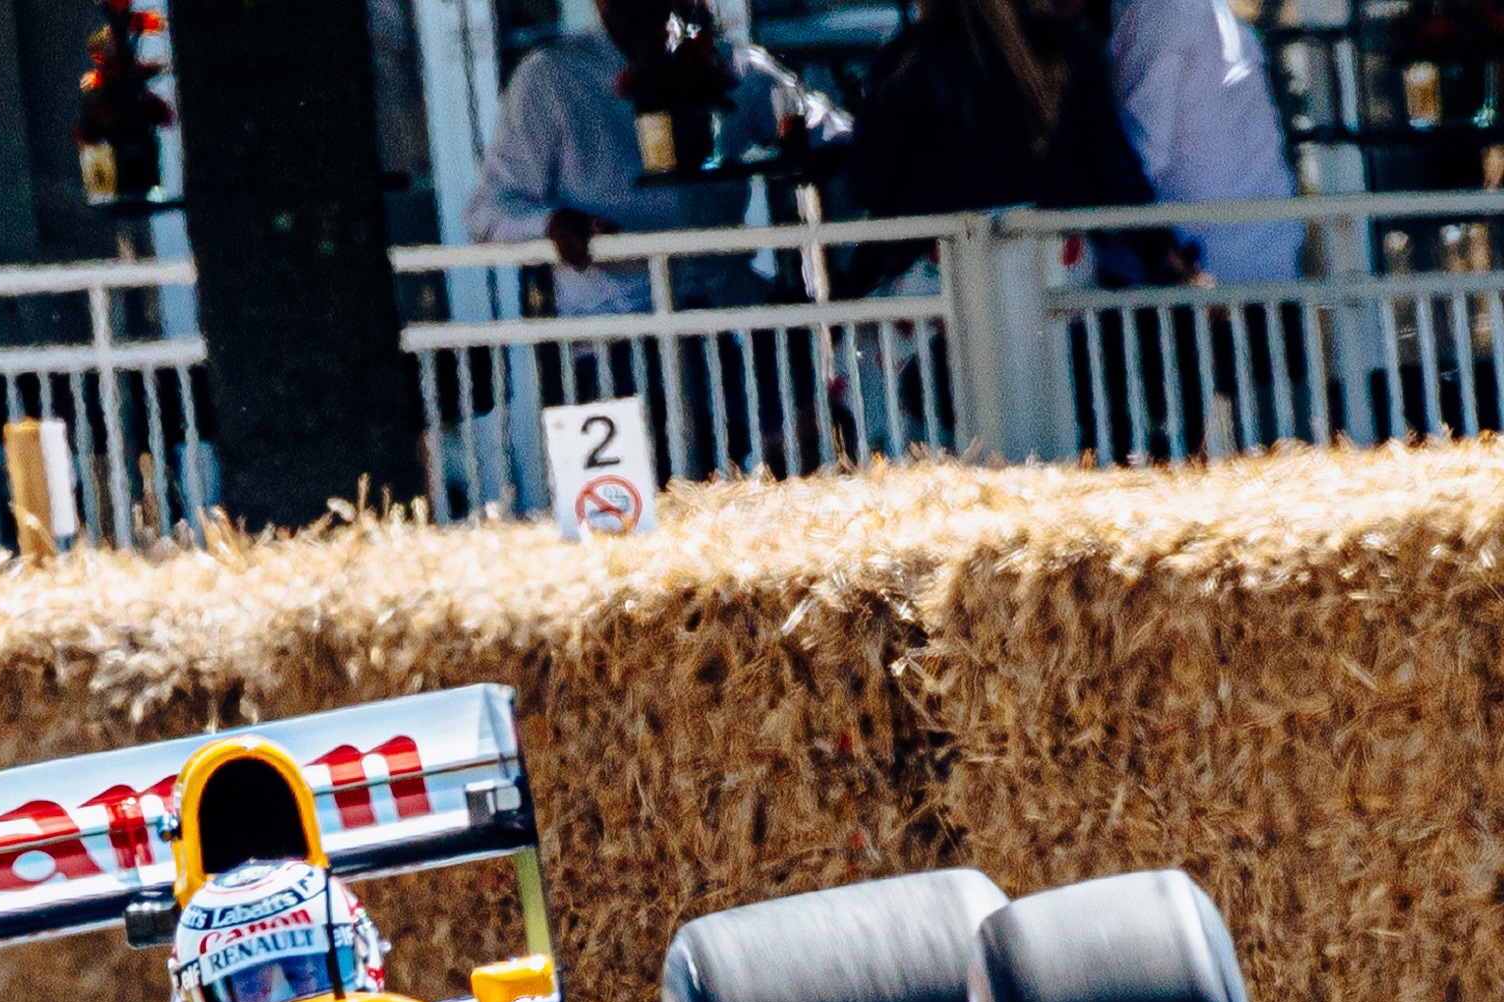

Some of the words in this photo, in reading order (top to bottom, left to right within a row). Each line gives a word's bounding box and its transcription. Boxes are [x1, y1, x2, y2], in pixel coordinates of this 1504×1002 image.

[580, 414, 621, 470] 2
[198, 908, 314, 956] Canon
[208, 928, 315, 973] RENAULT
